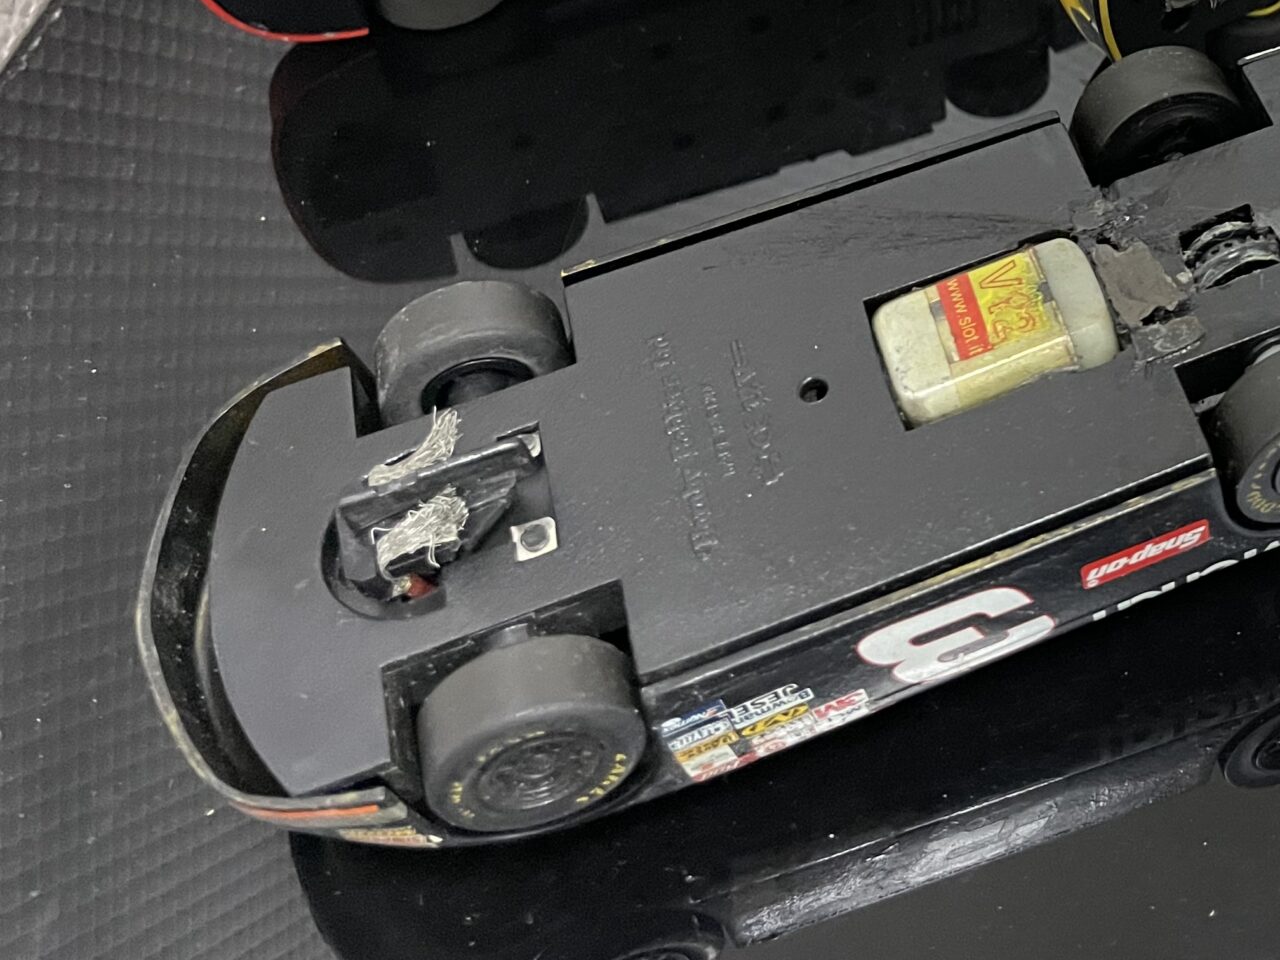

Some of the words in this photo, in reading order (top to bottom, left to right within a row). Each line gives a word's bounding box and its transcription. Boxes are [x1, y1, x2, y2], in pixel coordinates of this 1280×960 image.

[946, 278, 985, 357] www.slot.it
[857, 587, 1056, 684] 3
[719, 684, 798, 721] JESEL
[731, 691, 811, 727] Bowman
